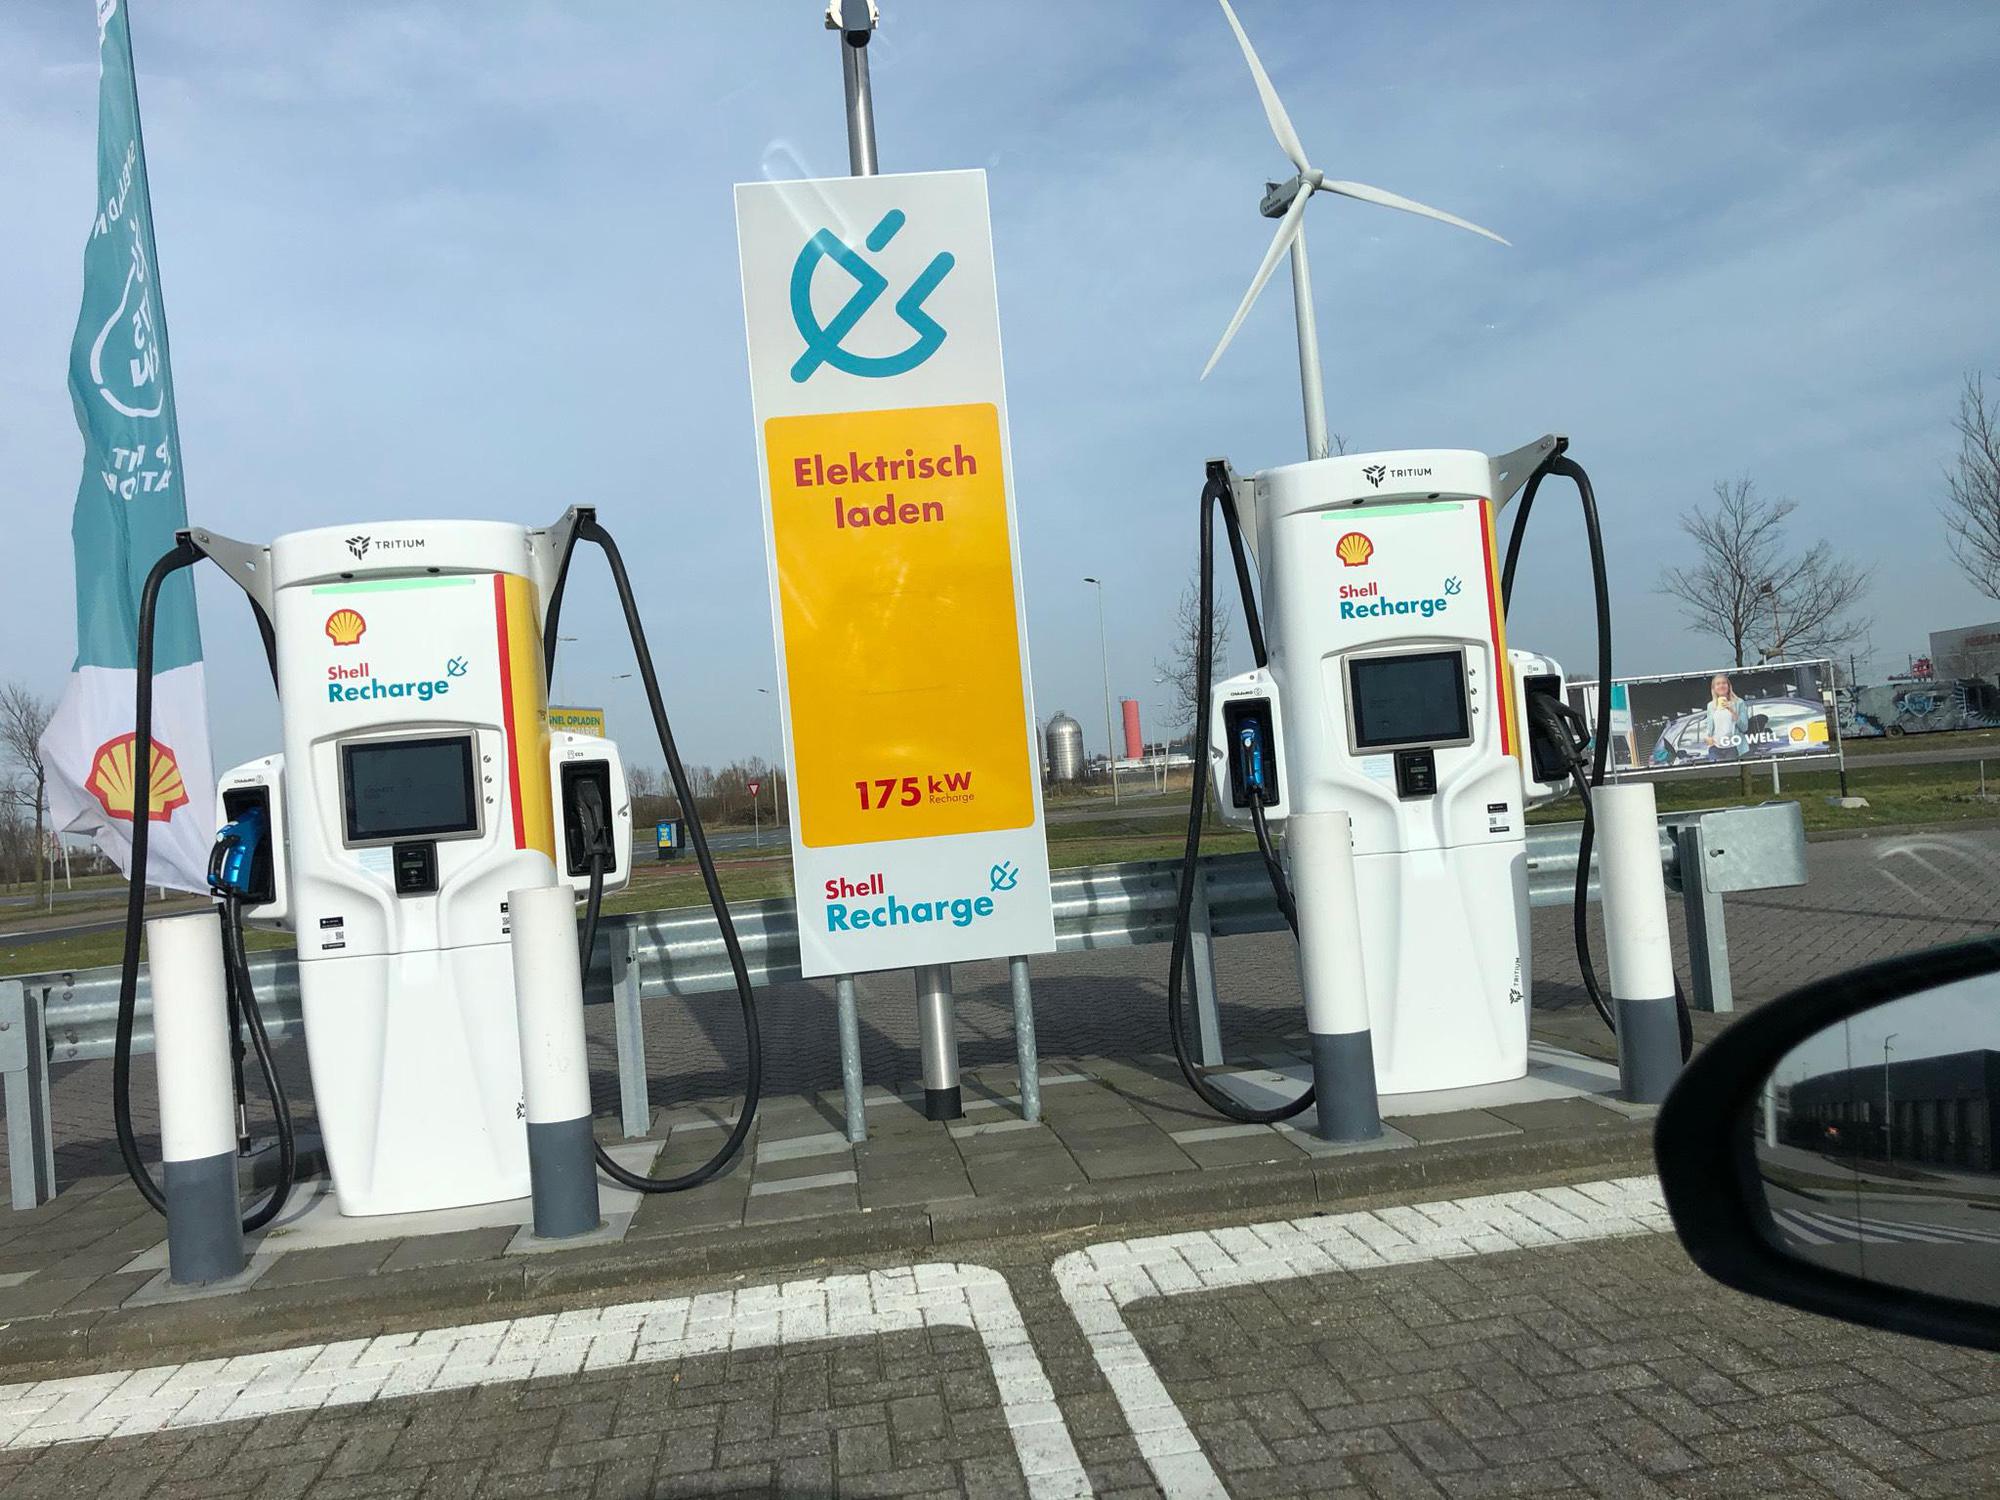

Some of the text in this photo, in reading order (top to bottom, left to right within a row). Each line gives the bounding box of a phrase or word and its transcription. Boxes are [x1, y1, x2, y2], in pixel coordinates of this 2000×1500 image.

[794, 444, 977, 488] Elektrisch
[1389, 468, 1433, 478] TRITIUM
[834, 493, 944, 529] laden
[374, 539, 426, 550] TRITIUM
[1339, 582, 1379, 599] Shell
[1339, 595, 1447, 620] Recharge
[328, 662, 370, 681] Shell
[328, 677, 450, 704] Recharge
[1720, 731, 1780, 747] GO WELL
[855, 776, 922, 811] 175
[927, 771, 972, 794] kW
[929, 793, 975, 804] Recharge
[826, 873, 884, 899] Shell
[827, 895, 994, 932] Recharge
[1513, 957, 1521, 987] TRITIUM
